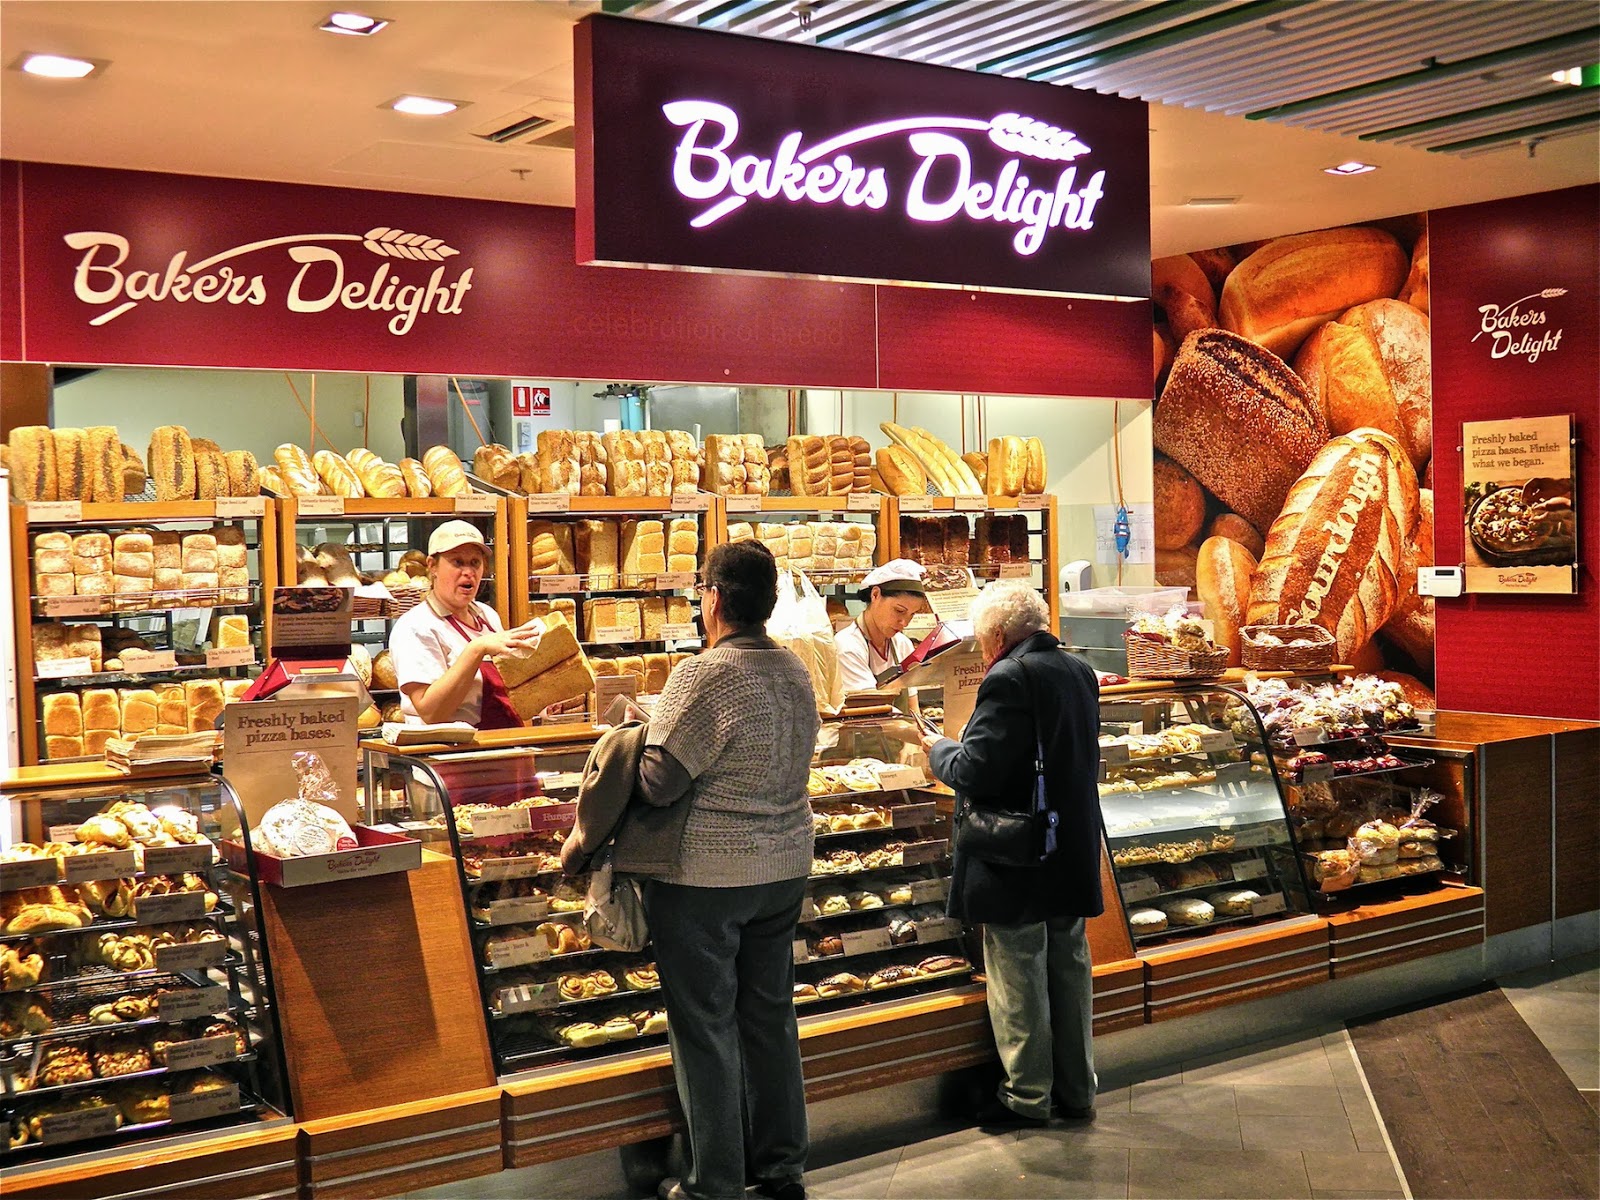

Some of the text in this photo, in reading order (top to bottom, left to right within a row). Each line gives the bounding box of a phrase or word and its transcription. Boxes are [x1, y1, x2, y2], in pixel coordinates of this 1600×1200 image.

[663, 100, 1106, 255] Bakers Delight
[64, 231, 474, 336] Bakers Delight
[570, 306, 725, 342] celebration
[771, 314, 843, 346] bread
[1478, 304, 1546, 333] Bakers
[1491, 329, 1563, 363] Delight
[1472, 431, 1538, 445] Freshly baked
[1472, 443, 1560, 458] pizza bases. Finish
[1472, 459, 1495, 468] what
[1512, 457, 1544, 468] began.
[1286, 453, 1384, 626] sourdough
[237, 709, 345, 730] Freshly baked
[245, 727, 335, 746] pizza bases.
[327, 858, 353, 871] Bakers
[354, 855, 380, 867] Delight
